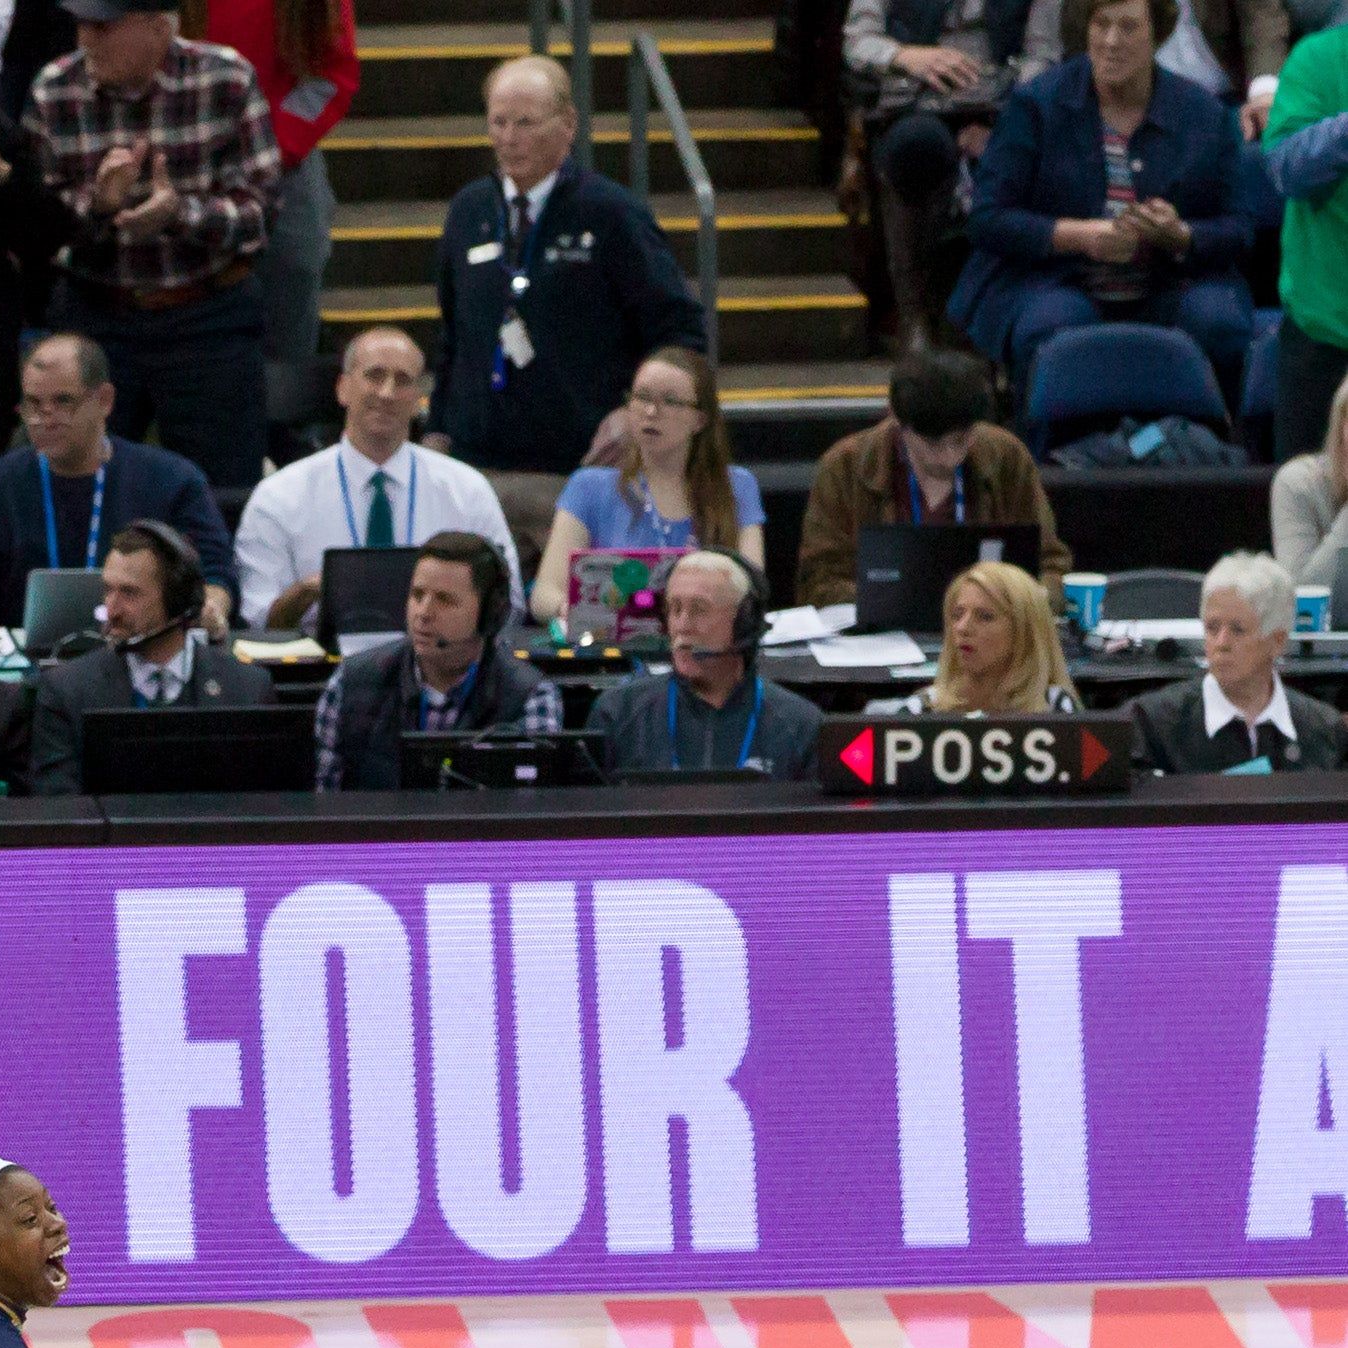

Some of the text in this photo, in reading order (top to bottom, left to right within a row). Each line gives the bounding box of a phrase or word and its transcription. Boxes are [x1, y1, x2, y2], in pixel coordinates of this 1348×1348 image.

[884, 729, 1071, 784] POSS.
[114, 879, 760, 1265] FOUR
[888, 868, 1123, 1248] IT
